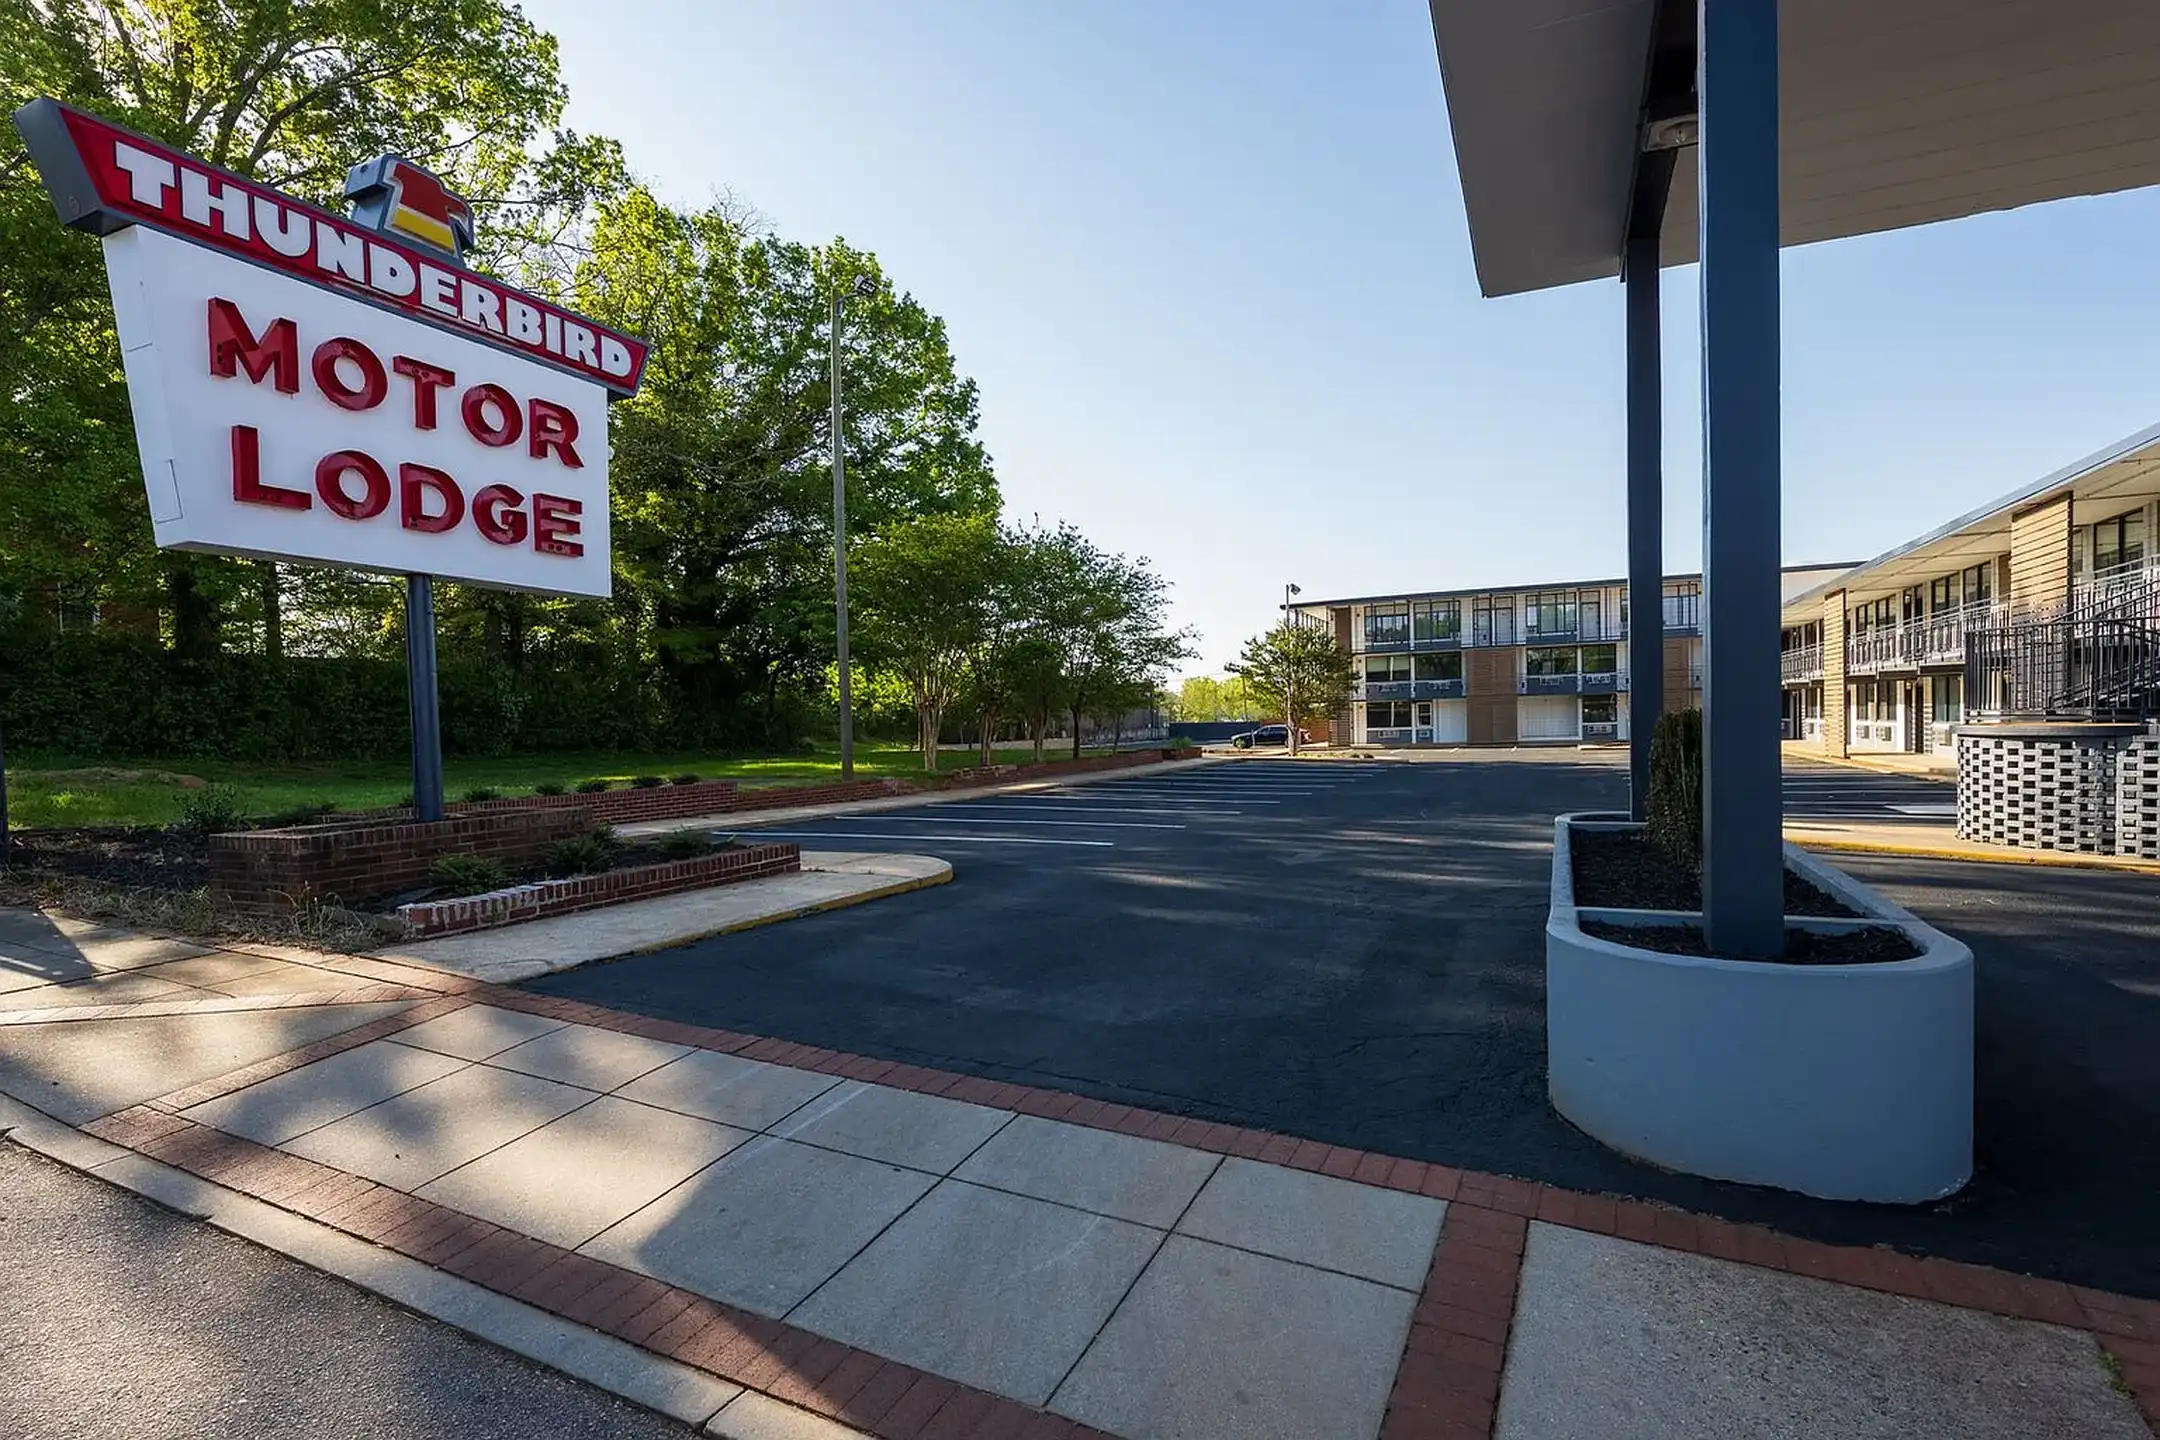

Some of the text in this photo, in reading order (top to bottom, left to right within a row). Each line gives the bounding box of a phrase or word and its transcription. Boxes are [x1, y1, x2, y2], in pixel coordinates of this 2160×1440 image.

[115, 140, 632, 377] THUNDERBIRD
[208, 297, 584, 468] MOTOR
[231, 424, 584, 557] LODGE
